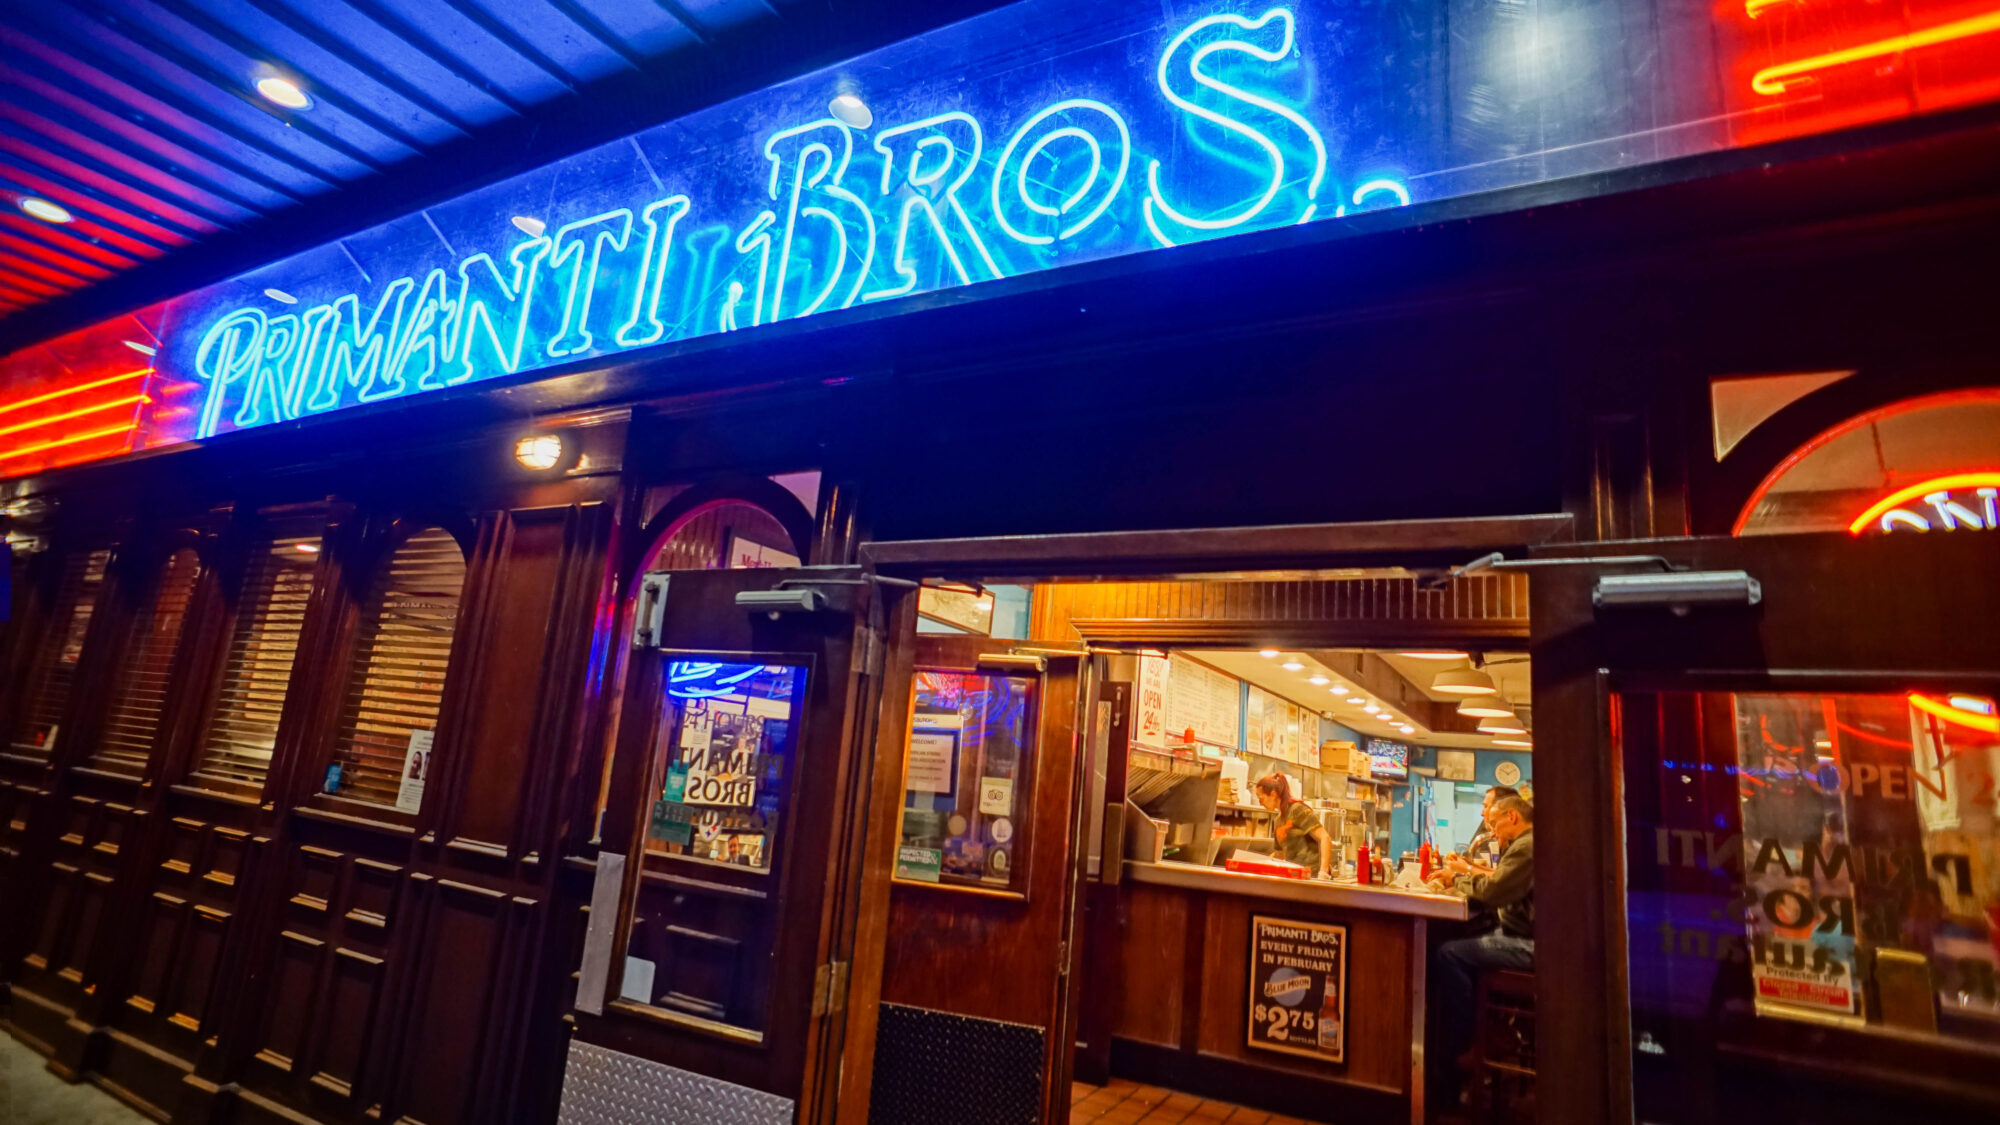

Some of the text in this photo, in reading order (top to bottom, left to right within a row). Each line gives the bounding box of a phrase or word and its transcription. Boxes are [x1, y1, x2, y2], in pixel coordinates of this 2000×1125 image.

[195, 194, 691, 440] PRIMANTI
[1143, 688, 1162, 711] OPEN
[1259, 924, 1339, 945] PRIMANTI BROS.
[1260, 940, 1336, 960] EVERY FRIDAY
[1262, 953, 1333, 972] IN FEBRUARY
[1265, 977, 1310, 996] BLUE MOON
